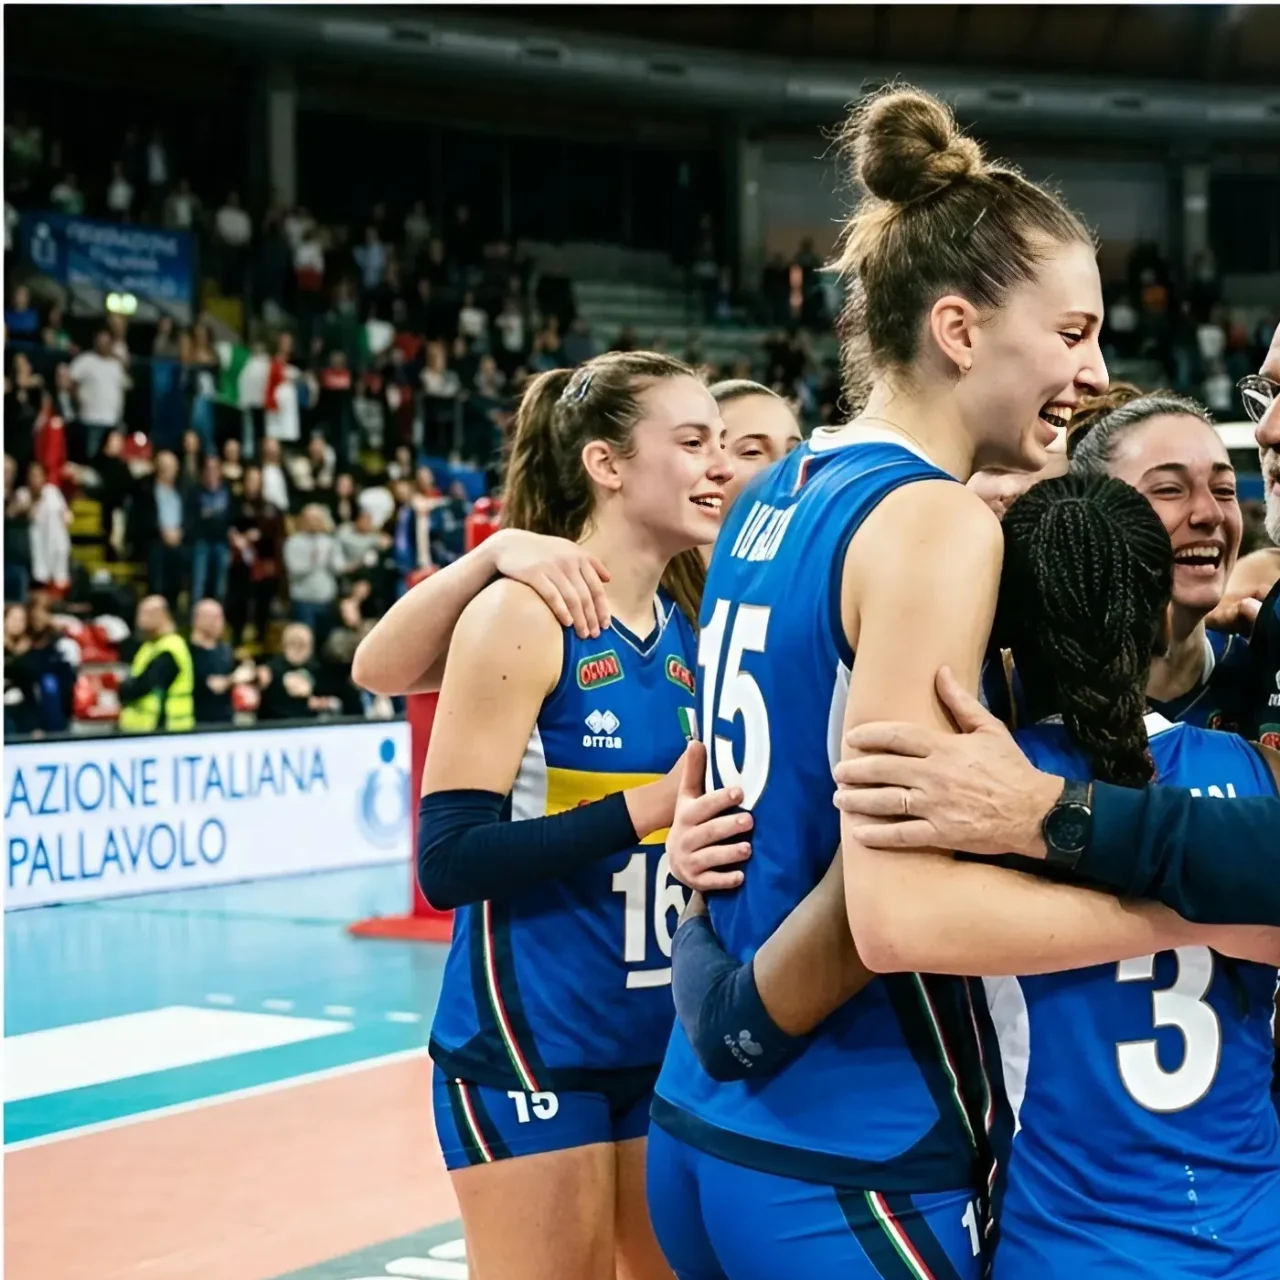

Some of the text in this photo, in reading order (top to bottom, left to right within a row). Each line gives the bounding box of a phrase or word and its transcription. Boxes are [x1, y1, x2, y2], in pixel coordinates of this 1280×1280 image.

[698, 596, 774, 811] 15
[4, 748, 328, 819] AZIONE ITALIANA
[7, 819, 228, 888] PALLAVOLO
[612, 852, 686, 962] 16
[1115, 944, 1222, 1114] 3
